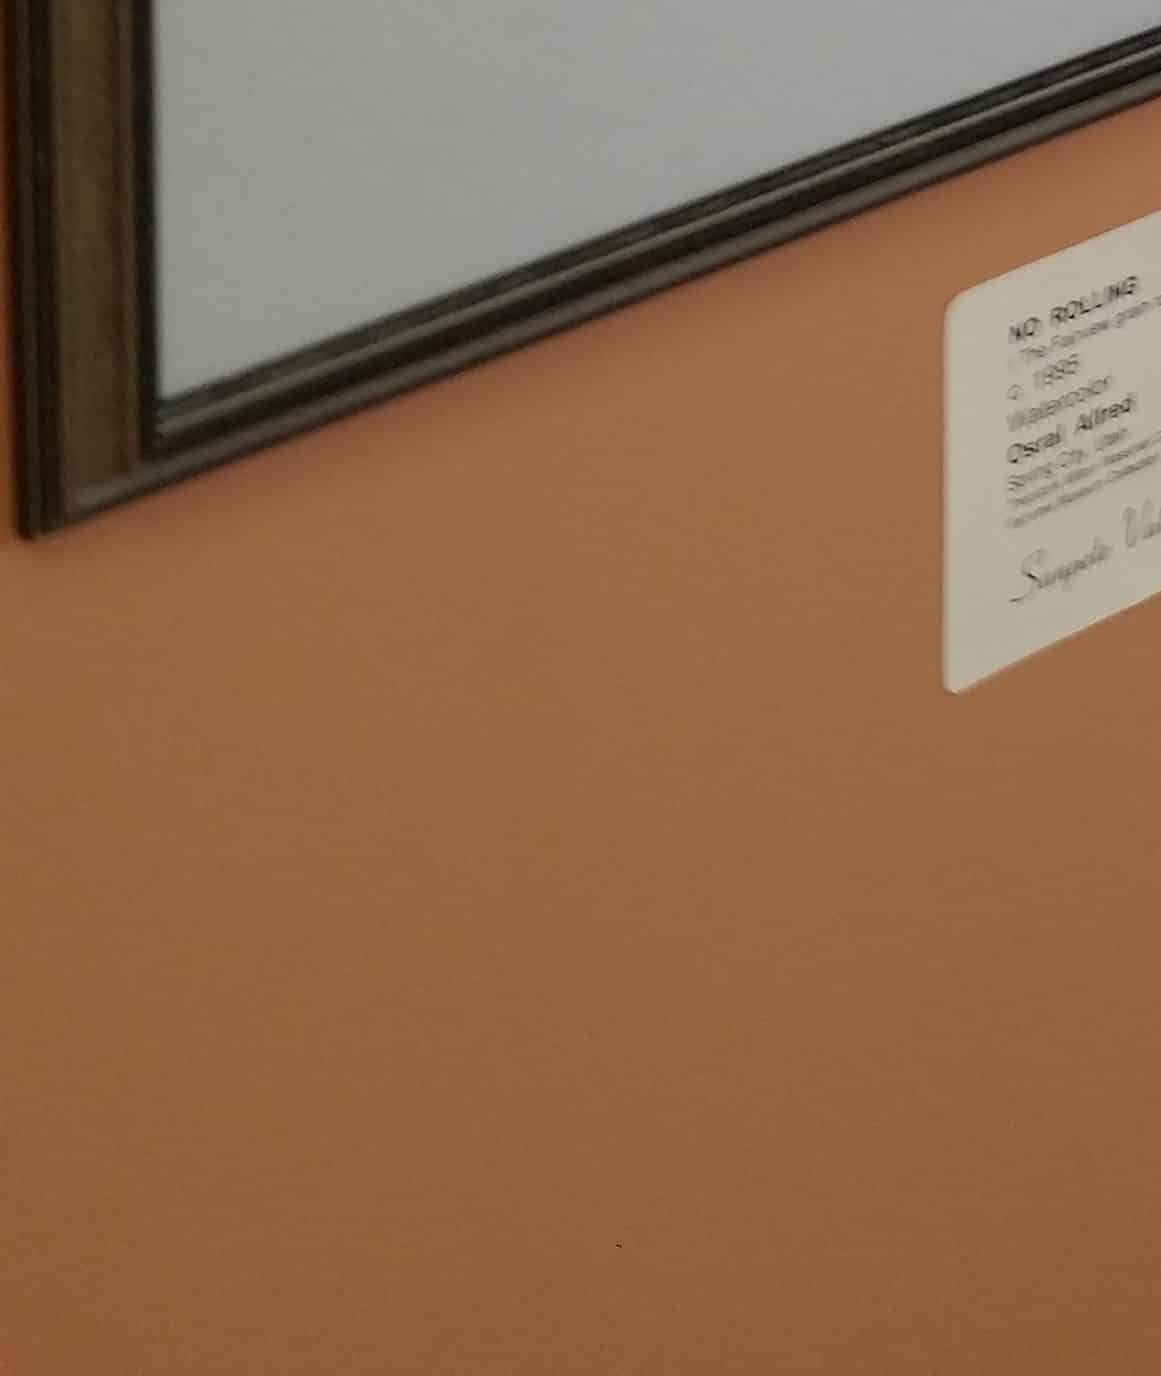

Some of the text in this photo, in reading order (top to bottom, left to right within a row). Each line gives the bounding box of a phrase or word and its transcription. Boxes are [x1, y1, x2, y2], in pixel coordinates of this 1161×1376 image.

[1007, 273, 1140, 344] NO ROLLING
[1005, 374, 1111, 432] Watercolor
